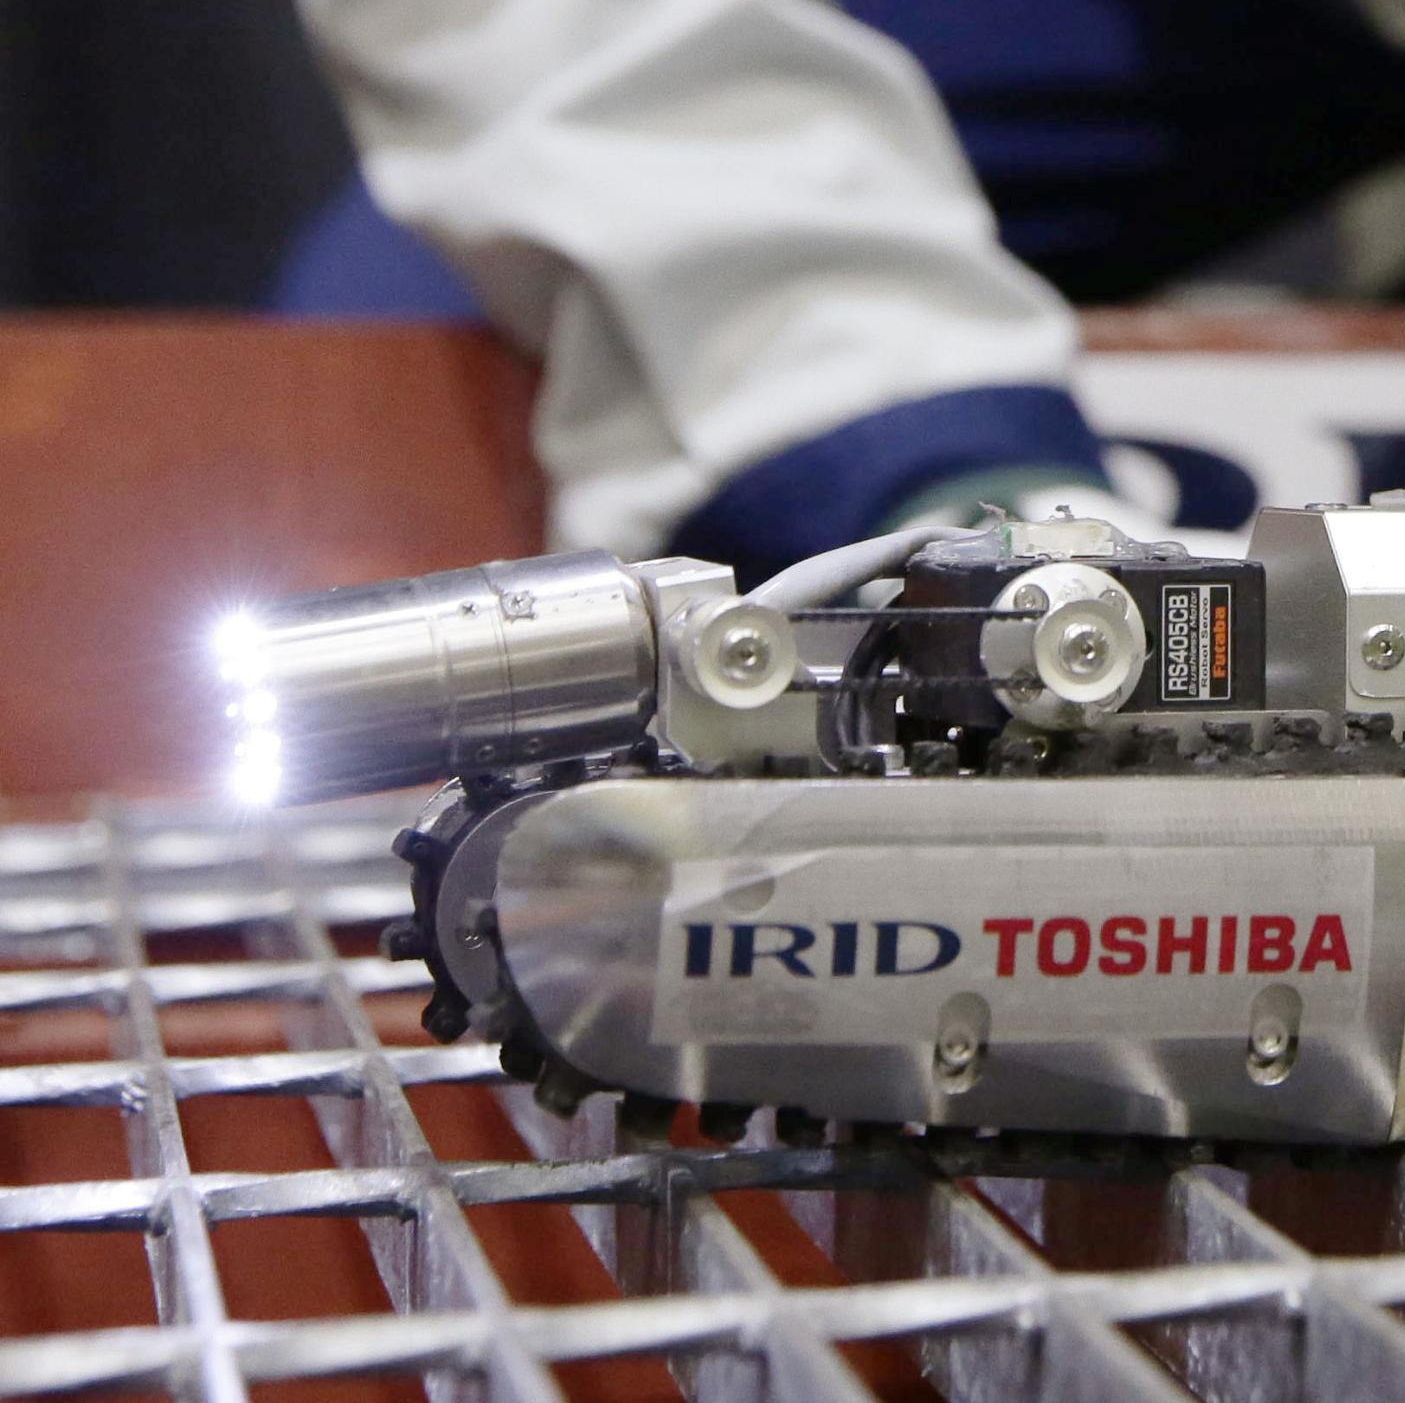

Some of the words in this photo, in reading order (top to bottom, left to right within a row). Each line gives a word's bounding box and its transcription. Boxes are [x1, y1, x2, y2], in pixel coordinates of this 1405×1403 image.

[1189, 591, 1198, 628] Motor
[1201, 597, 1209, 640] Servo
[1212, 606, 1227, 678] Futaba
[1168, 594, 1190, 692] RS405CB
[1189, 629, 1198, 696] Brushless
[1201, 643, 1209, 688] Robot
[683, 920, 962, 979] IRID
[982, 914, 1352, 978] TOSHIBA
